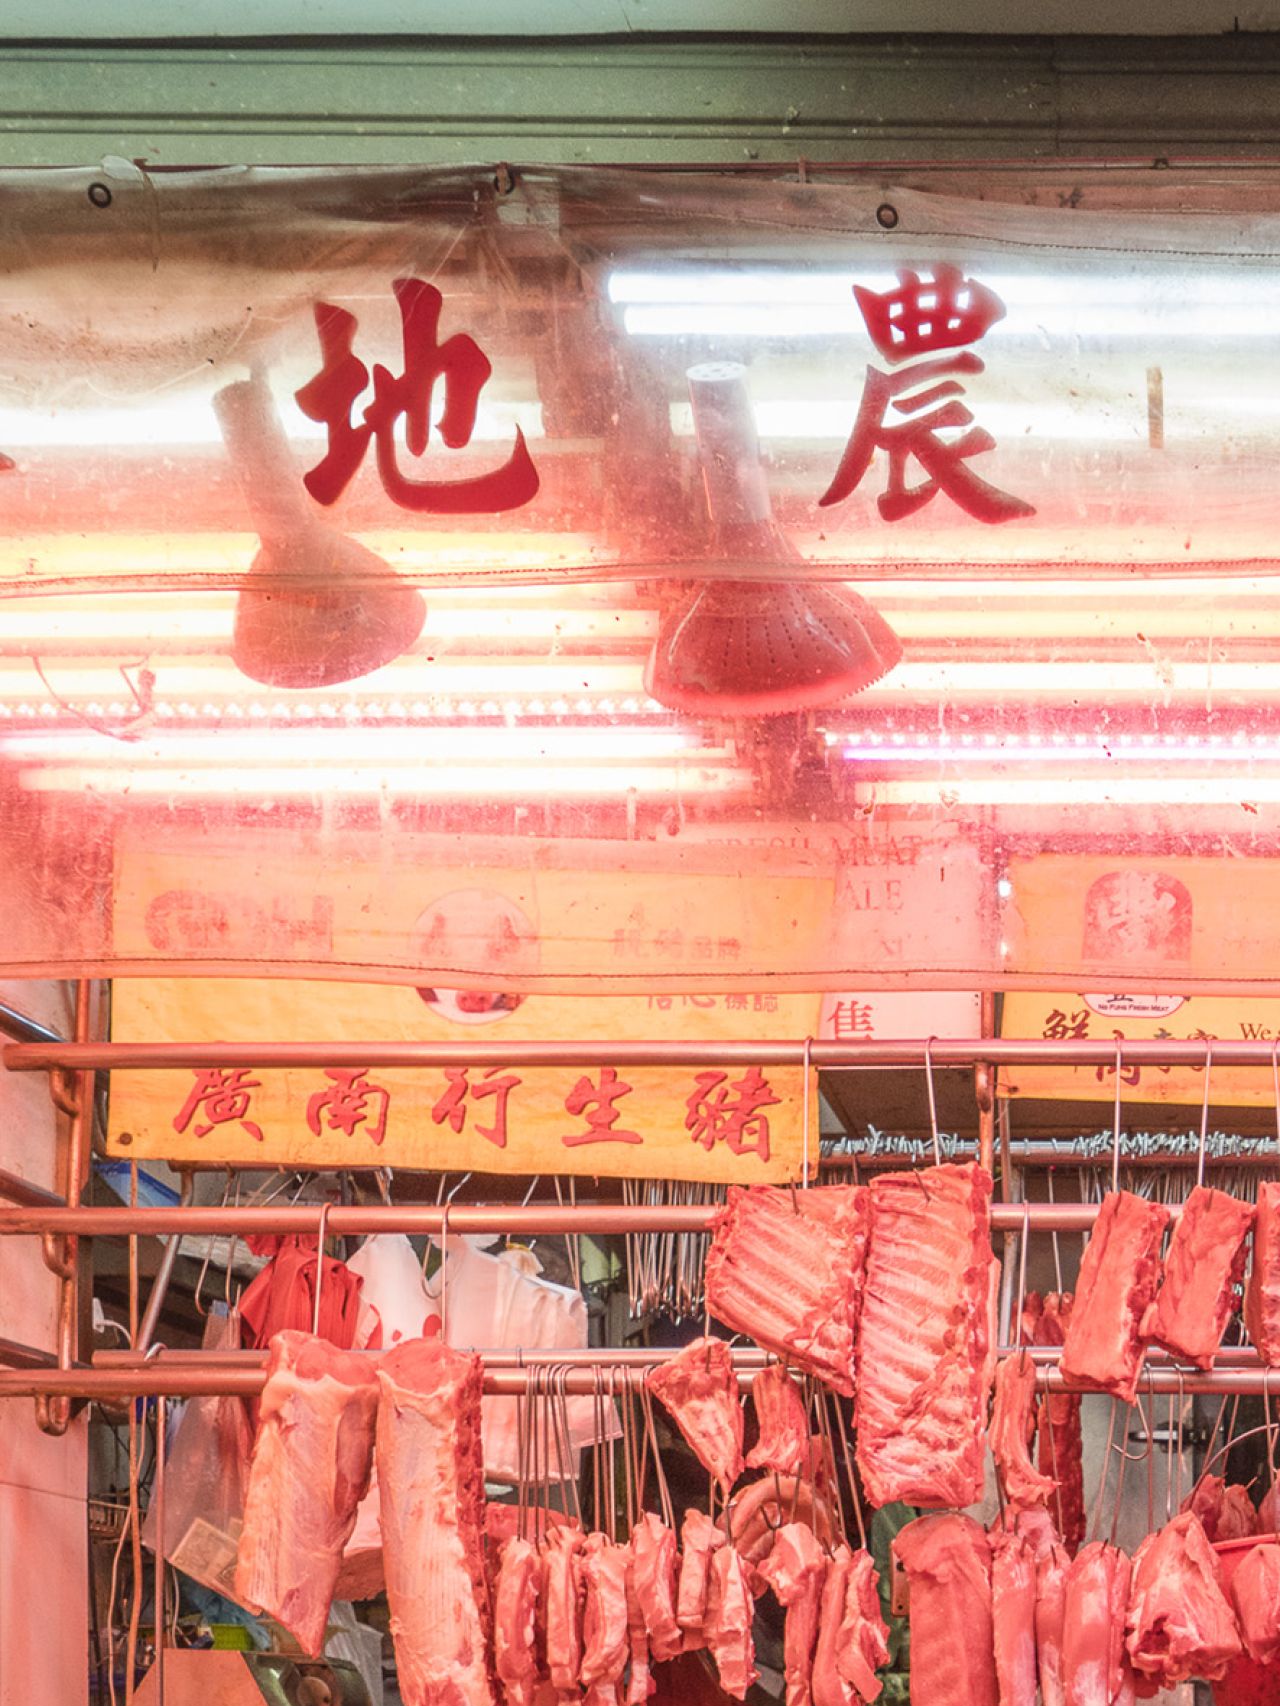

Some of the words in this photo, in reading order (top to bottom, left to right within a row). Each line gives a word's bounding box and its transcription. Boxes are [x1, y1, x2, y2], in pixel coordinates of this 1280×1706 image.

[1240, 1023, 1272, 1040] We
[172, 1067, 783, 1162] 廣南行生豬
